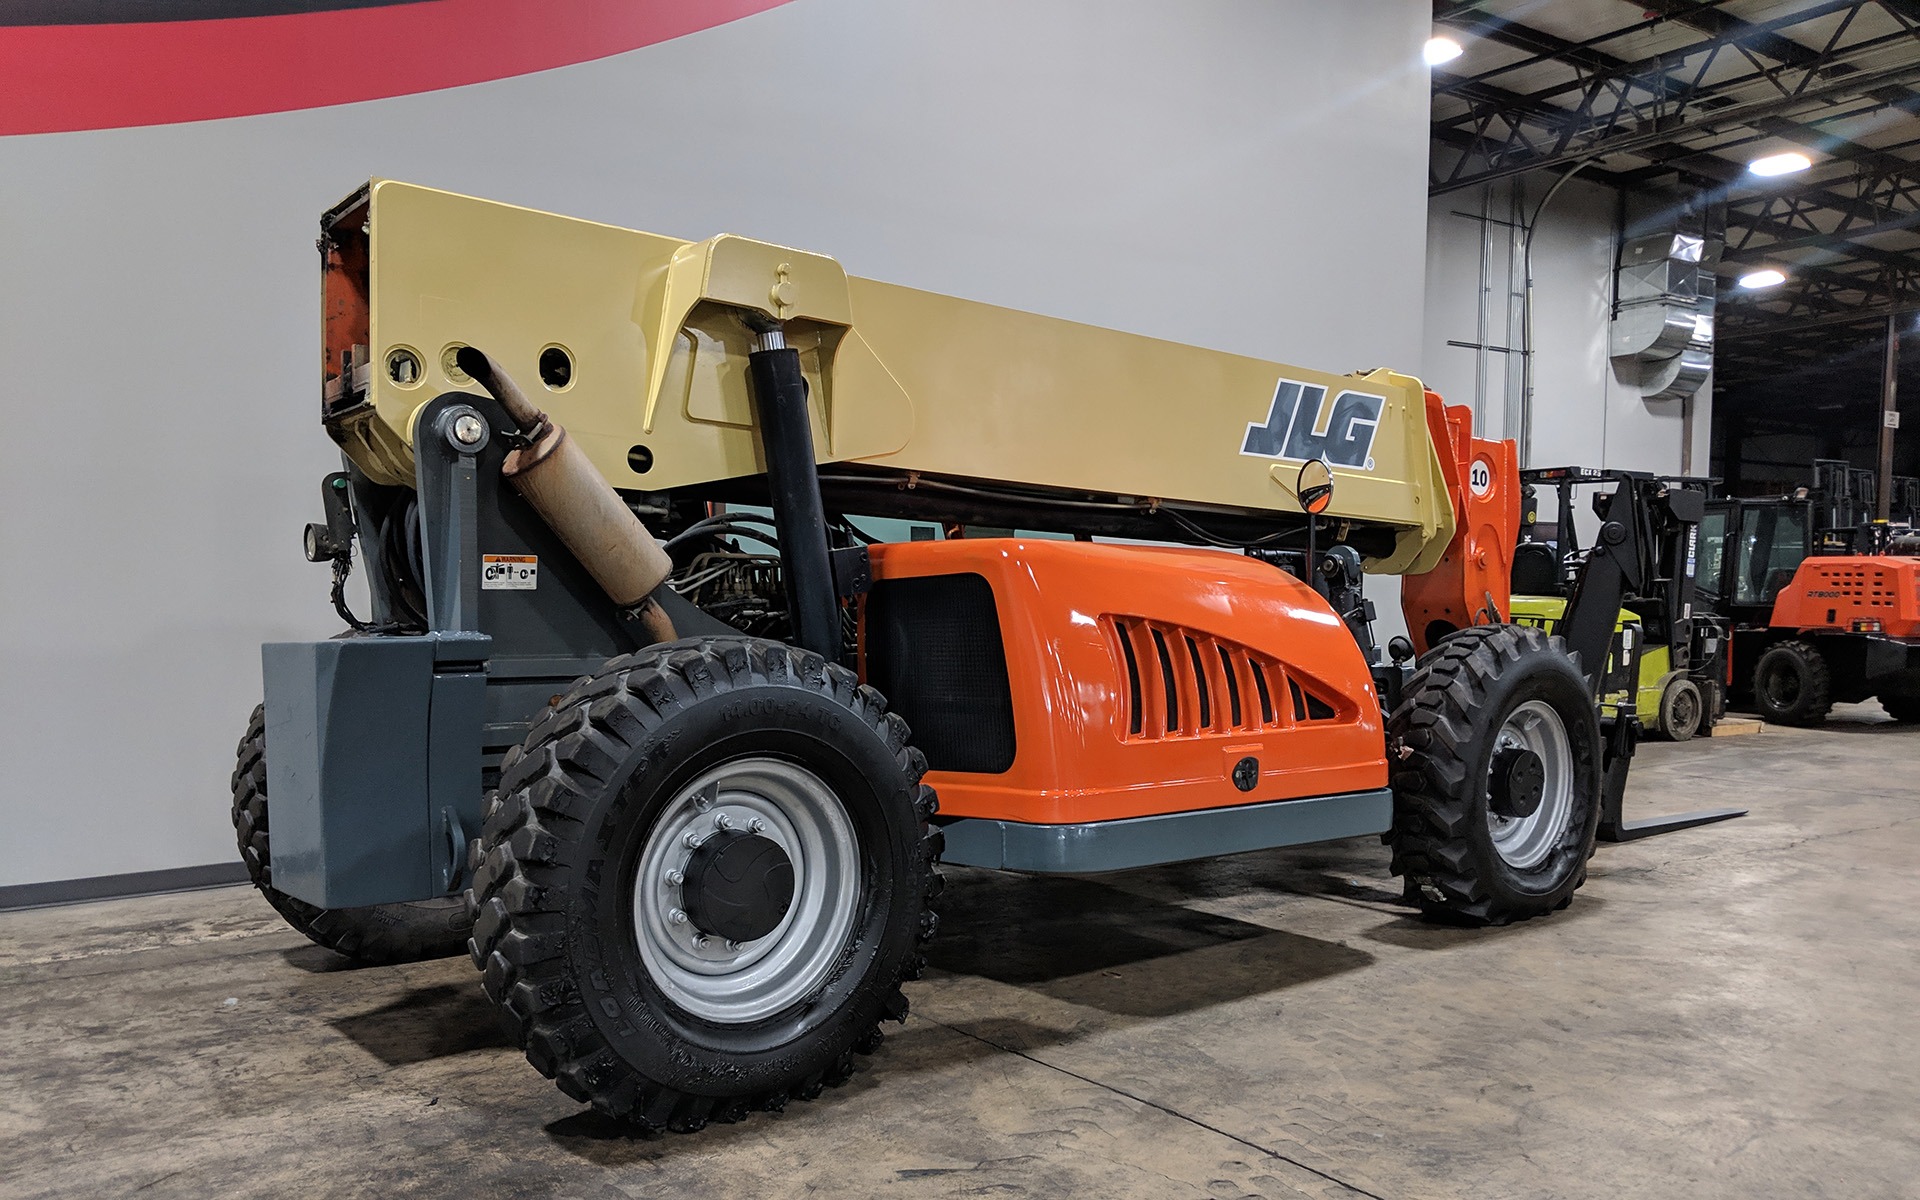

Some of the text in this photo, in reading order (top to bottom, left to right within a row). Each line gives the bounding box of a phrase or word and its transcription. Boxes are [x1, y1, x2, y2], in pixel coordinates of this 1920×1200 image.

[1239, 378, 1387, 470] JLG
[1471, 468, 1488, 487] 10
[1688, 524, 1698, 558] CLARK
